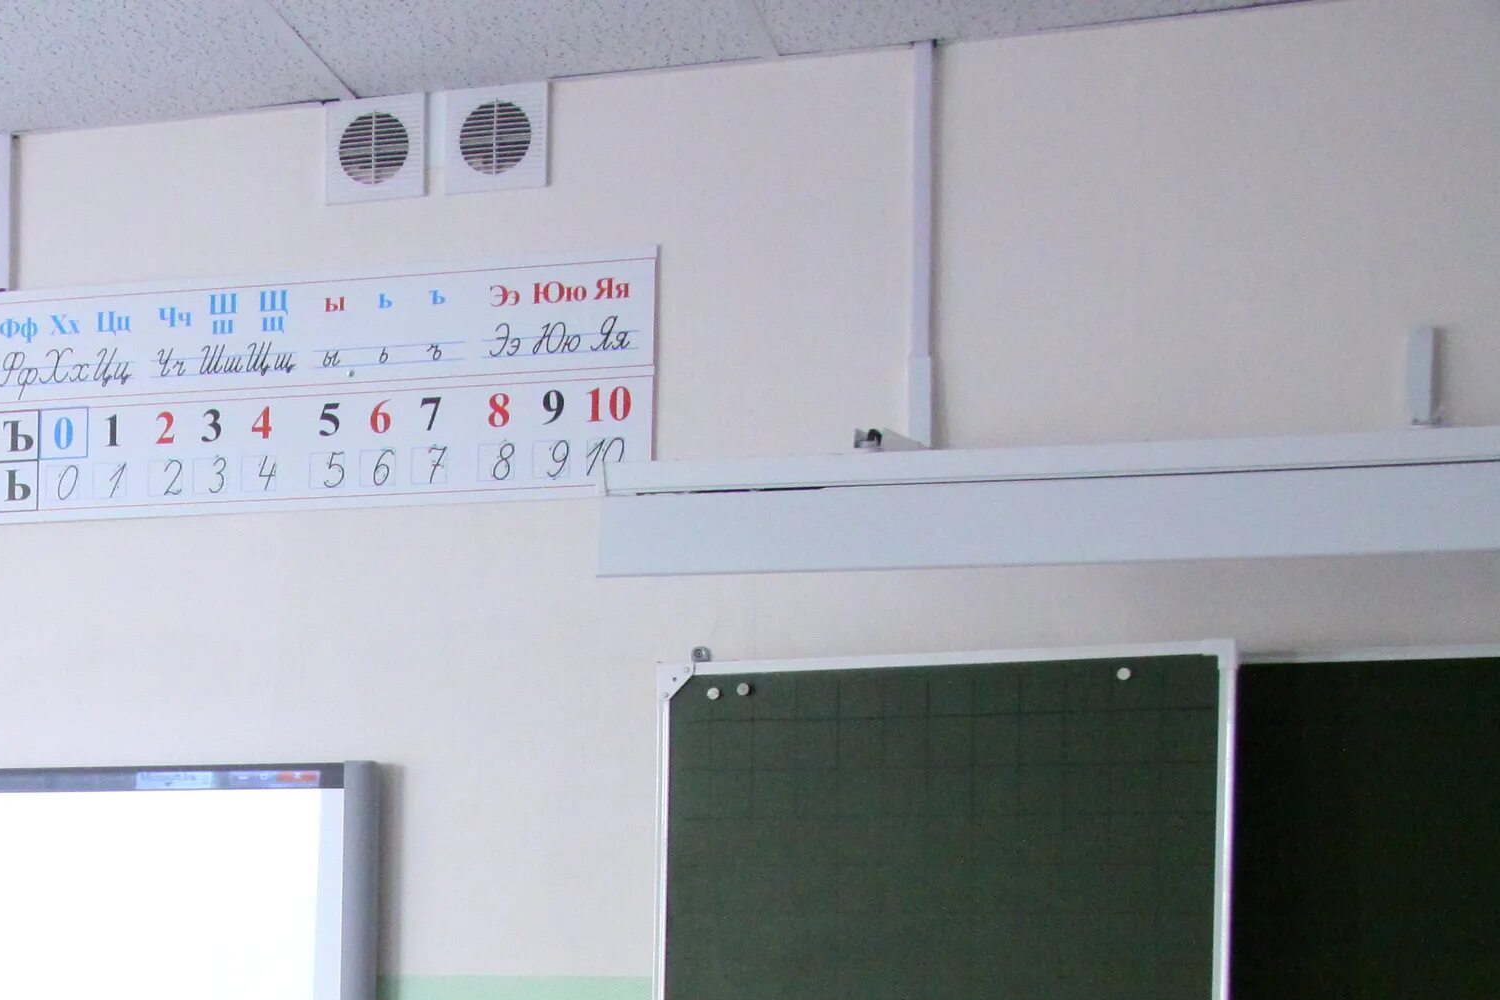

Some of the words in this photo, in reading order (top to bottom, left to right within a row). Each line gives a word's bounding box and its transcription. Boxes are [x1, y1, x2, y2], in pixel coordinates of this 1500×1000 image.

[0, 318, 38, 343] Фф
[50, 314, 80, 335] Хх
[97, 312, 131, 336] Цц
[159, 306, 191, 327] Чч
[490, 285, 520, 307] Ээ
[533, 281, 587, 304] Юю
[594, 277, 630, 300] Яя
[54, 417, 73, 450] 0
[105, 414, 120, 446] 1
[155, 412, 175, 444] 2
[201, 409, 221, 442] 3
[252, 406, 272, 439] 4
[319, 403, 340, 436] 5
[370, 400, 391, 433] 6
[420, 397, 442, 431] 7
[488, 393, 509, 427] 8
[542, 390, 564, 425] 9
[586, 386, 631, 422] 10
[110, 462, 127, 497] 1
[164, 459, 182, 495] 2
[209, 457, 226, 494] 3
[259, 456, 276, 490] 4
[323, 452, 344, 488] 5
[373, 449, 394, 486] 6
[428, 446, 447, 483] 7
[492, 443, 515, 480] 8
[547, 440, 569, 477] 9
